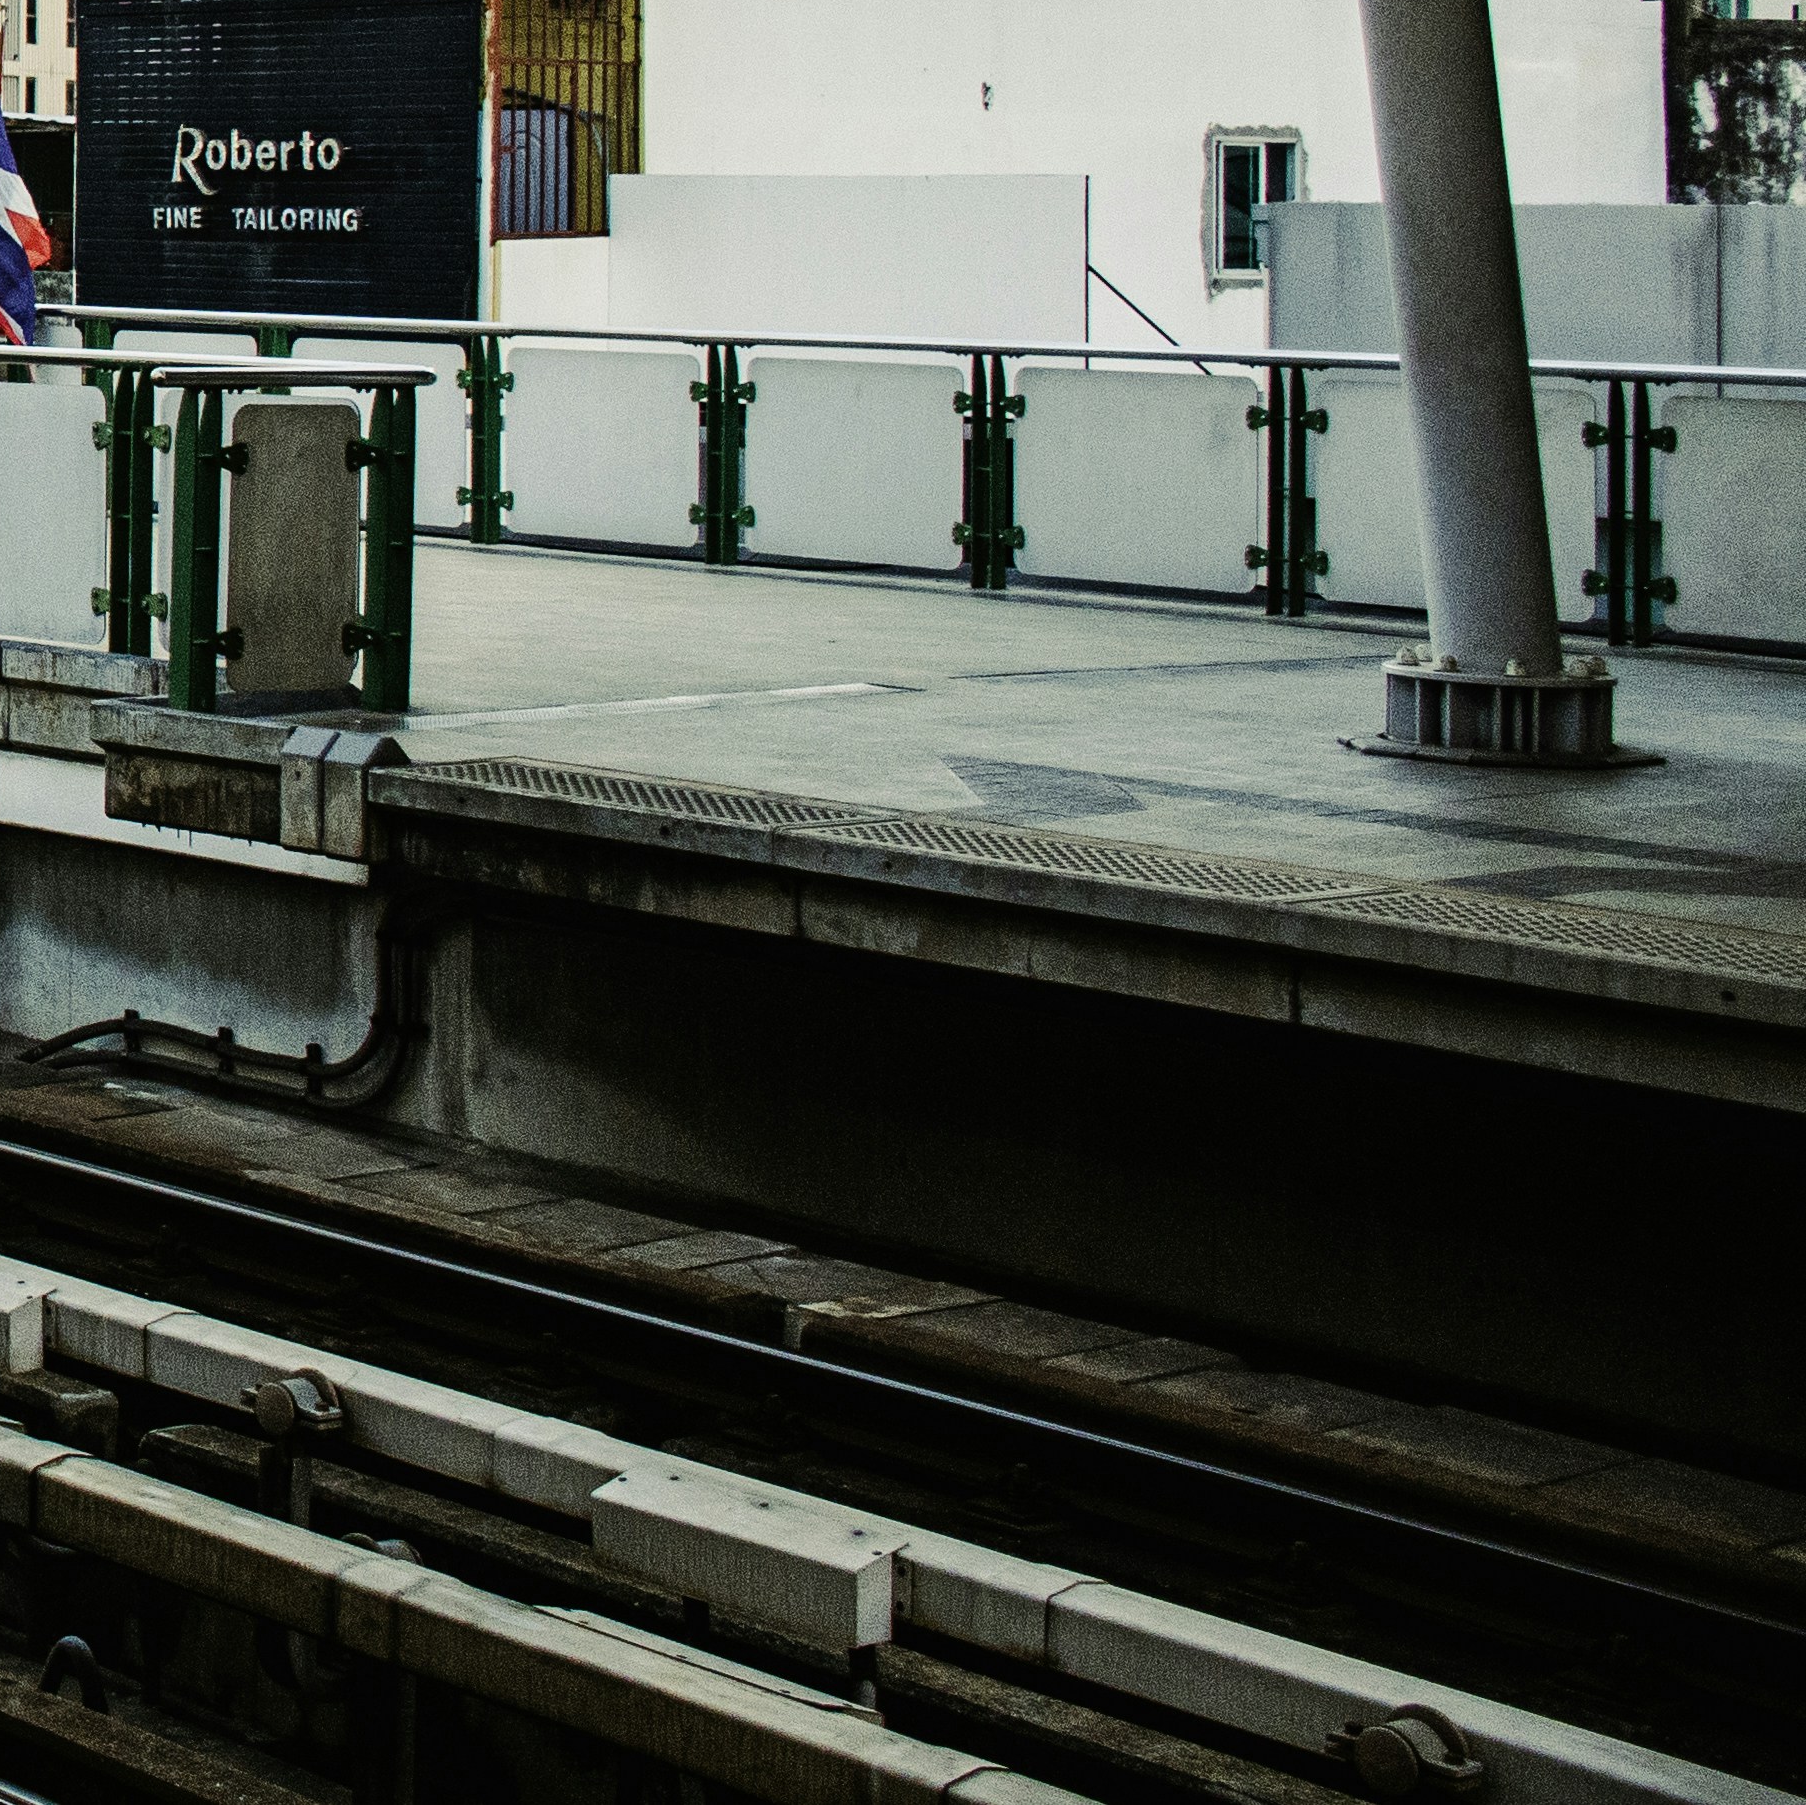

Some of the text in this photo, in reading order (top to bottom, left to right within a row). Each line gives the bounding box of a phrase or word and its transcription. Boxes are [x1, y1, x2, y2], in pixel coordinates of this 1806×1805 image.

[171, 124, 340, 195] Roberto
[153, 207, 359, 232] FINE TAILORING
